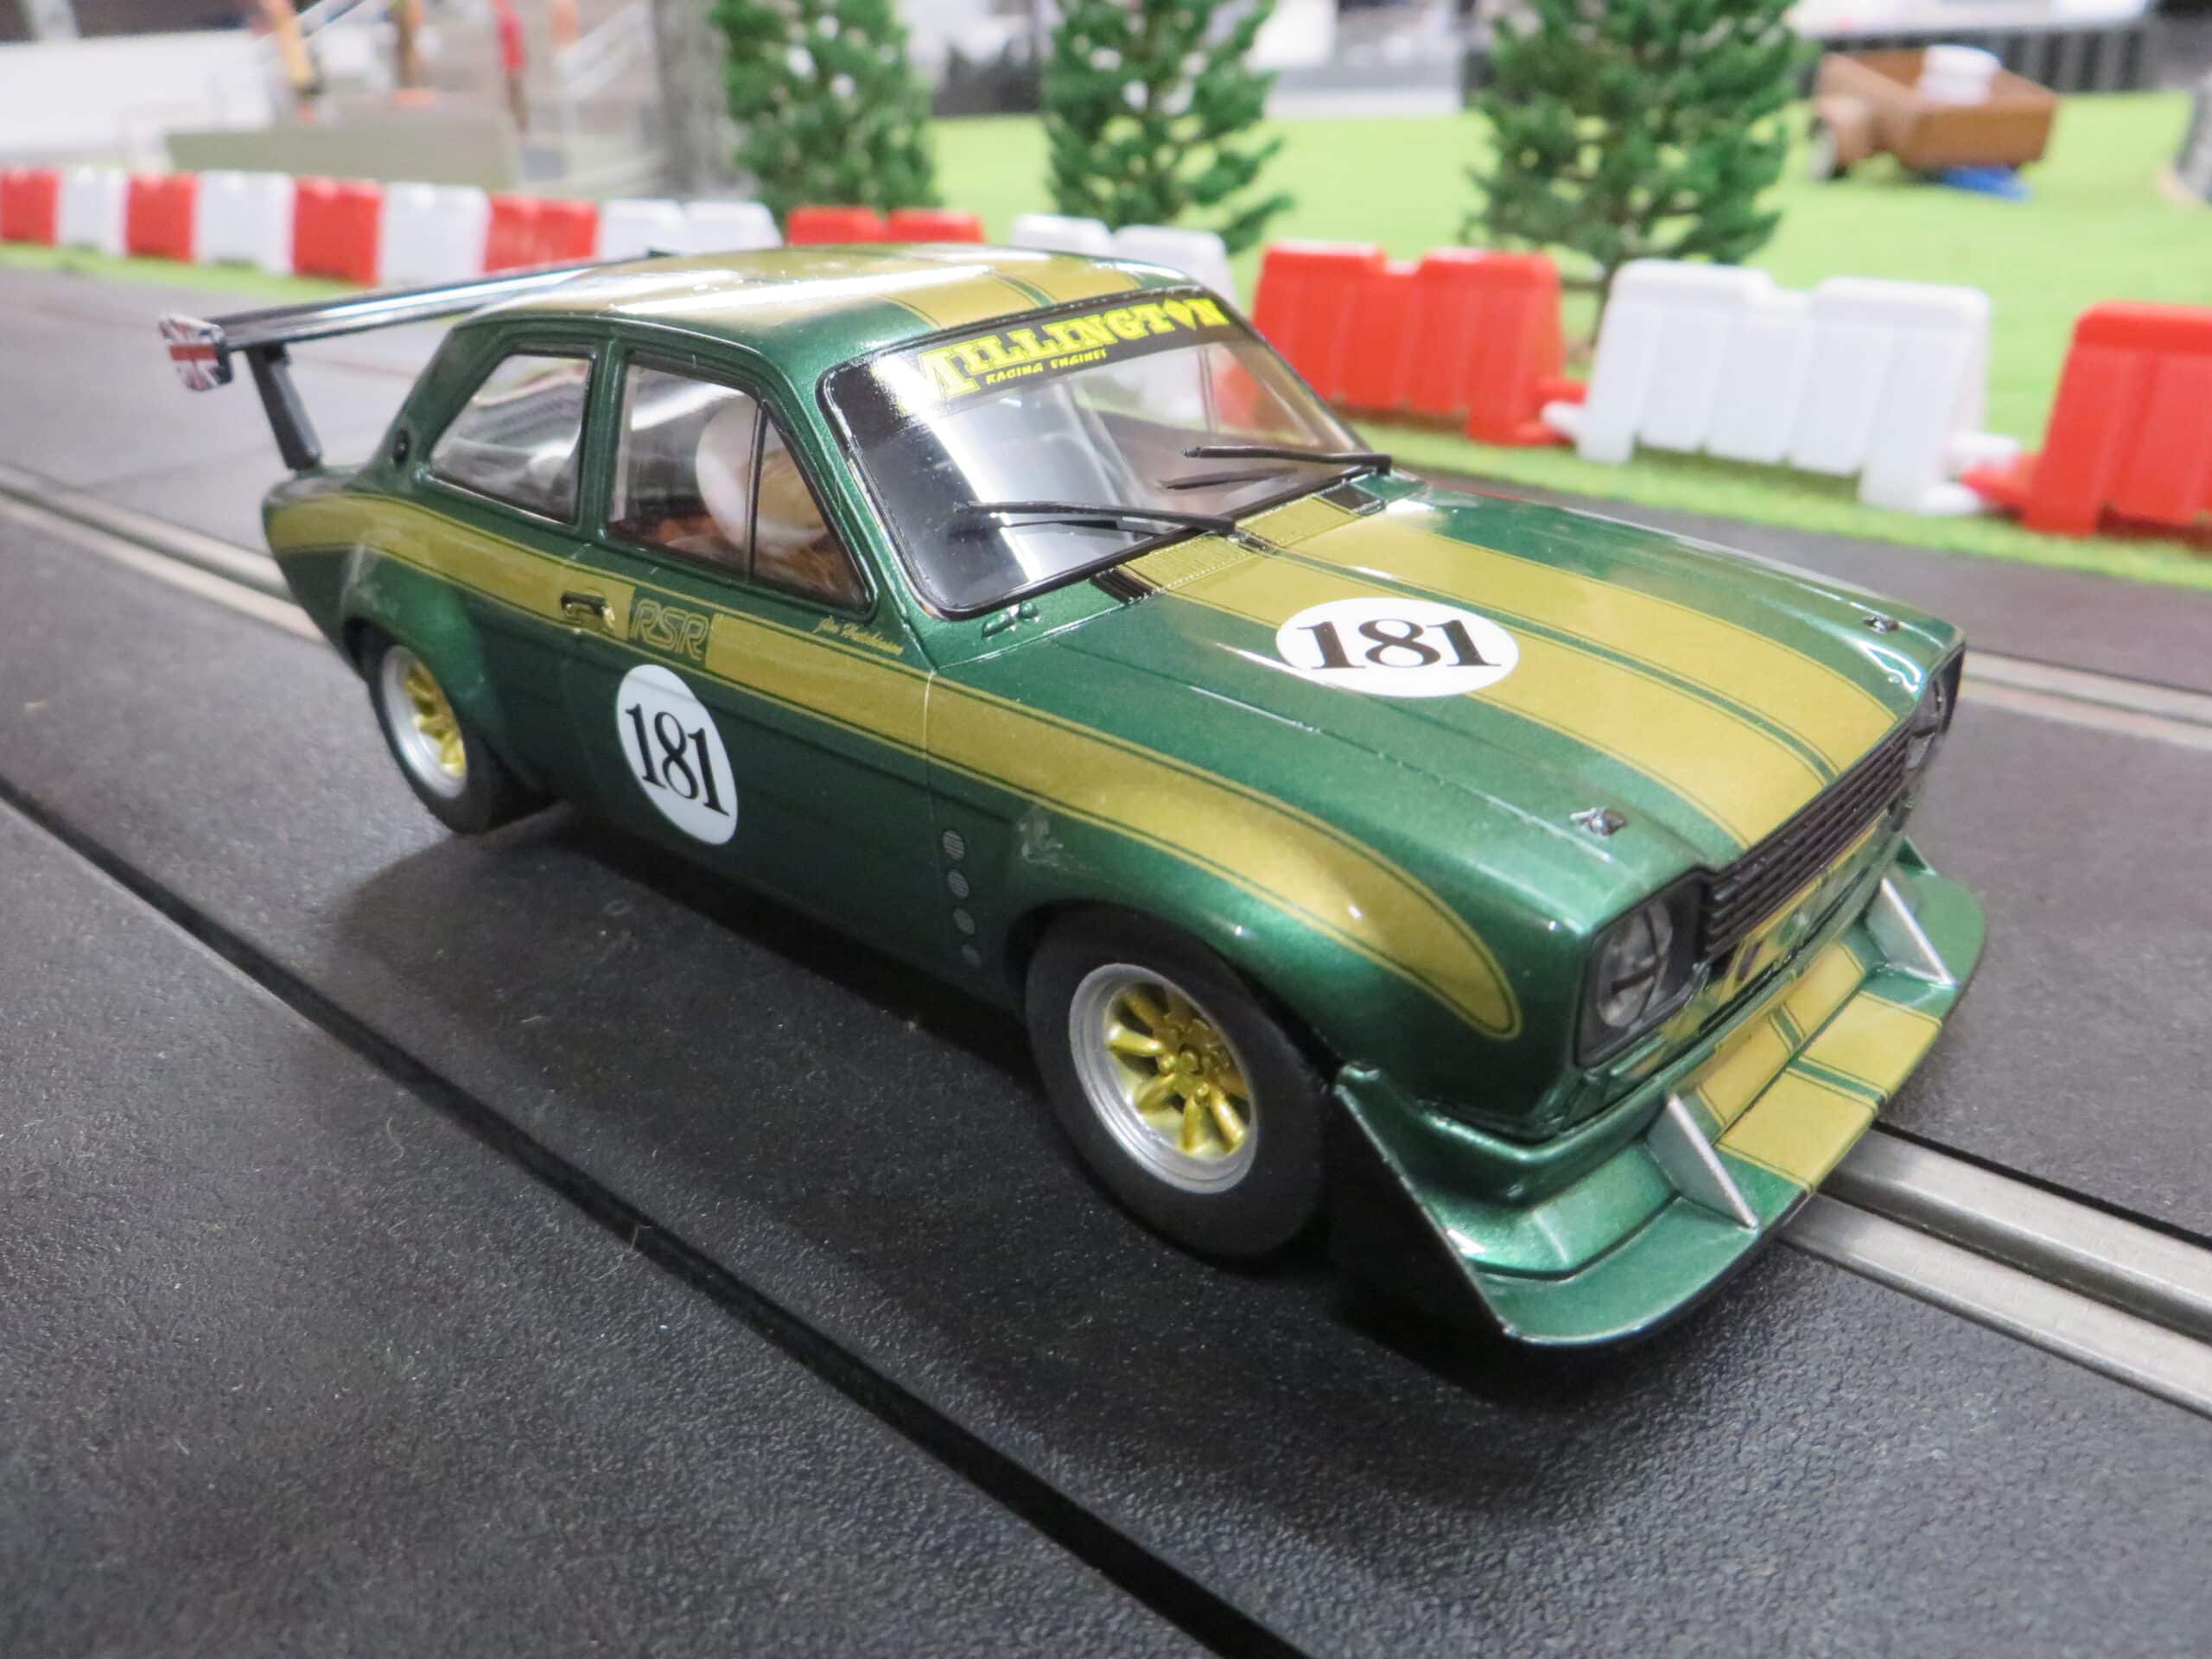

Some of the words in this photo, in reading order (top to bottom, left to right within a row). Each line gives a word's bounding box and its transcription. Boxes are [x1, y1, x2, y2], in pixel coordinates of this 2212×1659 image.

[986, 362, 1044, 385] RACING
[630, 598, 709, 661] RSR
[1296, 618, 1502, 670] 181
[625, 703, 730, 817] 181
